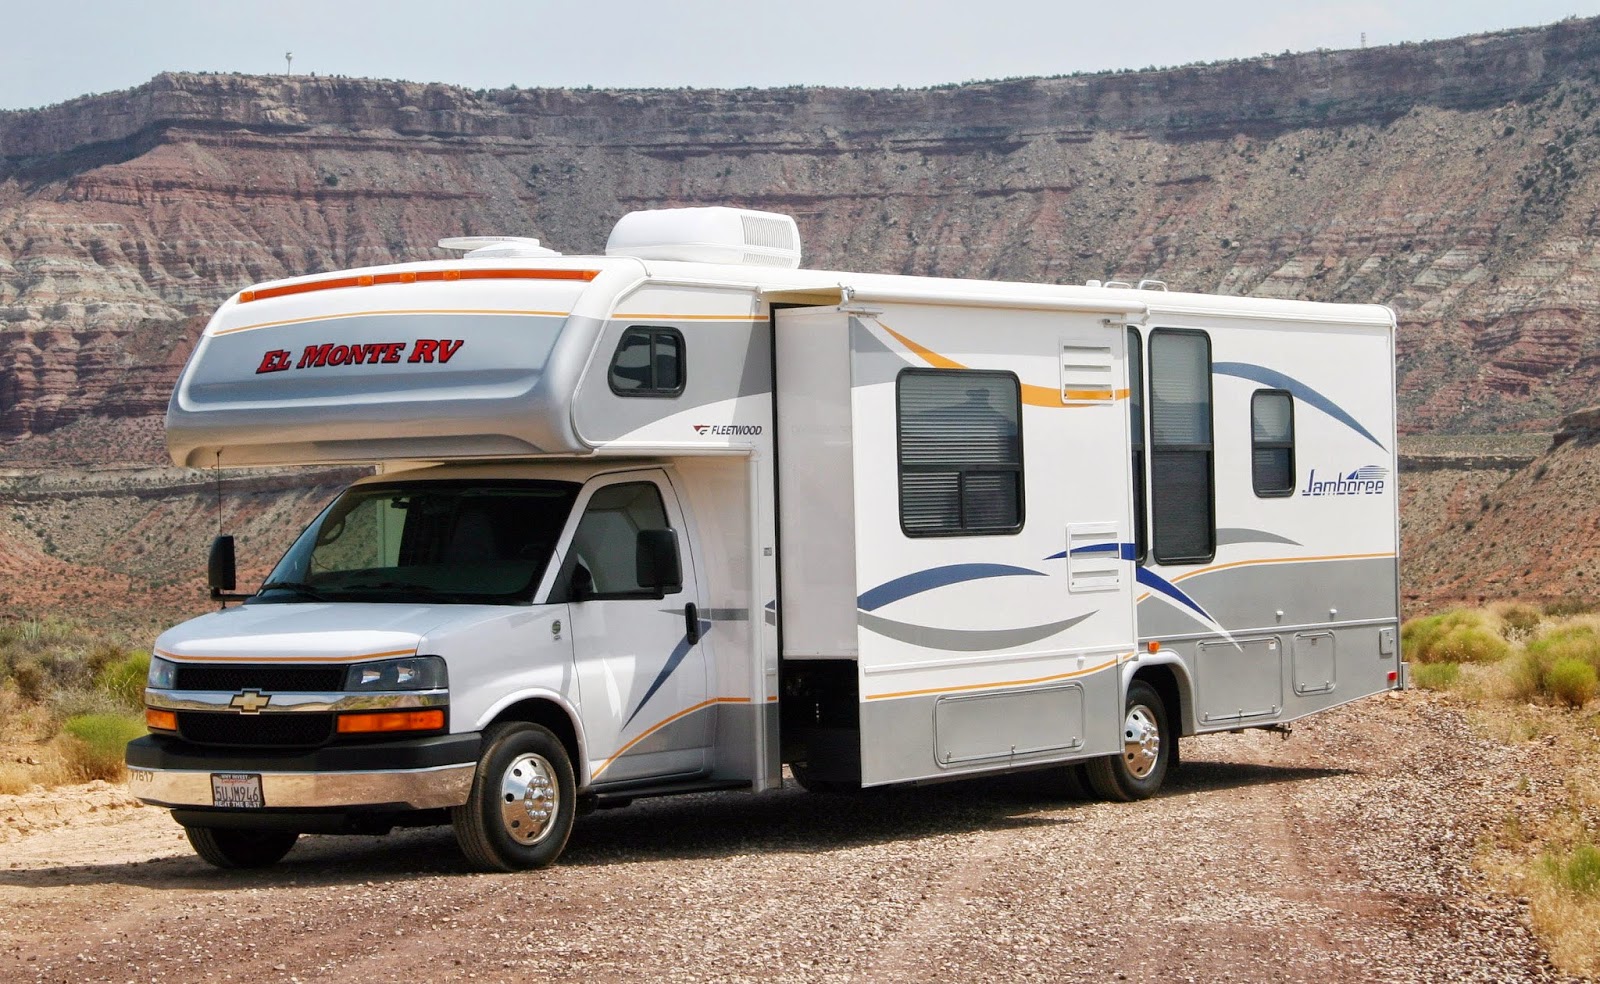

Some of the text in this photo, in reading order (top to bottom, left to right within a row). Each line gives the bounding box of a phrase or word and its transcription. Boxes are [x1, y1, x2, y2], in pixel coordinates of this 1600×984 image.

[255, 339, 465, 374] EL MONTE RV
[711, 425, 763, 436] FLEETWOOD
[1302, 469, 1384, 496] Jamboree
[215, 786, 259, 801] 5UJM946
